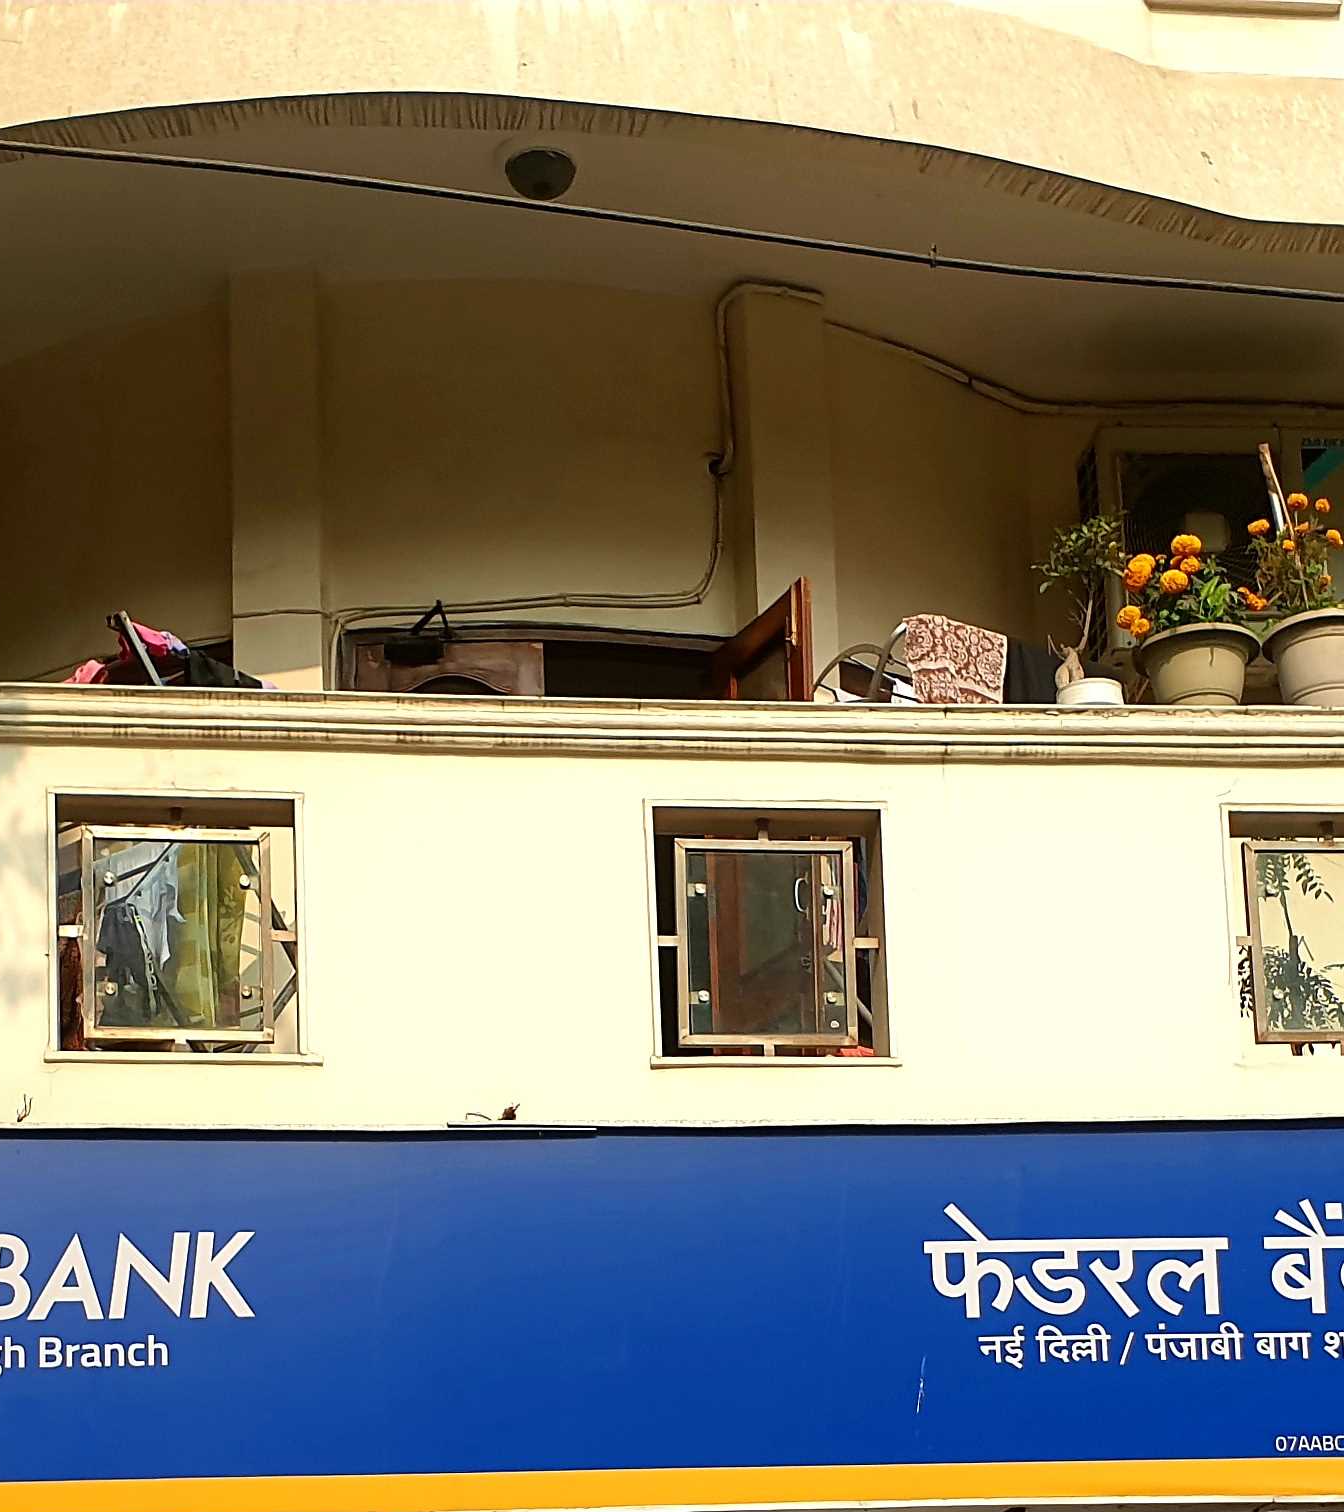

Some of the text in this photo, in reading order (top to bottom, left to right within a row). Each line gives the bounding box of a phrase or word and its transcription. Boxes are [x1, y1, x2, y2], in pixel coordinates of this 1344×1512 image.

[923, 1201, 1229, 1319] फेडरल
[39, 1334, 169, 1369] Branch
[978, 1324, 1024, 1368] नई
[1035, 1323, 1111, 1364] दिल्ली
[1119, 1332, 1135, 1366] /
[1145, 1321, 1243, 1361] पंजाबी
[1254, 1331, 1311, 1360] बाग
